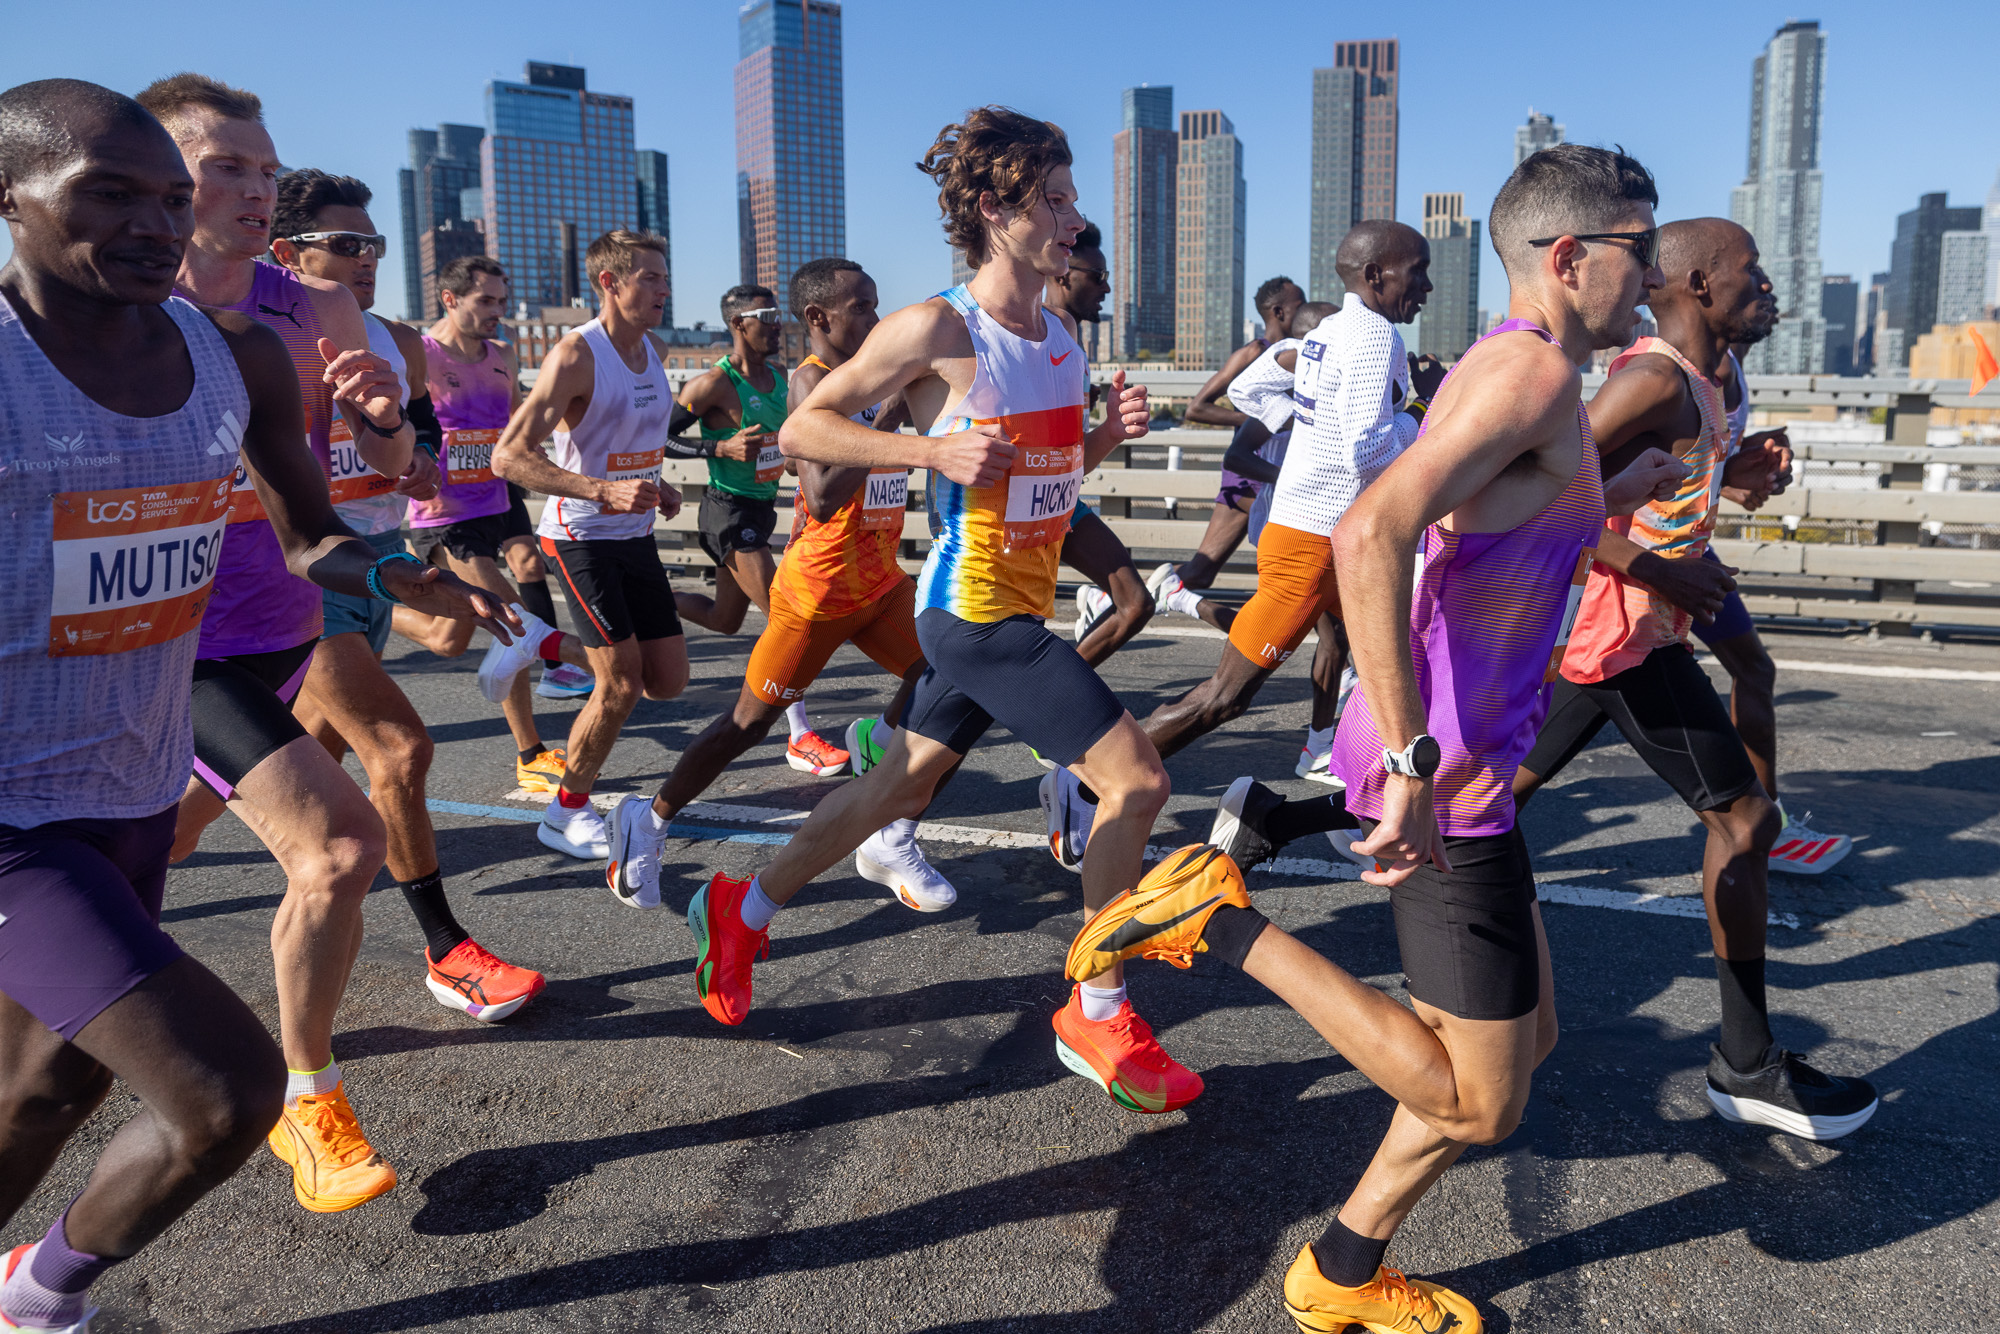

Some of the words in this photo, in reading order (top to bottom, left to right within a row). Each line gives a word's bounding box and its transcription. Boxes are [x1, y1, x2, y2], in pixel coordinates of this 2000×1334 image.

[11, 456, 70, 472] Tirop's
[72, 452, 121, 467] Angels
[616, 455, 632, 466] tcs
[1025, 451, 1048, 468] tcs
[141, 491, 168, 501] TATA
[141, 496, 201, 511] CONSULTANCY
[1030, 478, 1076, 517] HICKS
[87, 498, 136, 524] tcs
[141, 507, 178, 520] SERVICES
[89, 529, 221, 606] MUTISO
